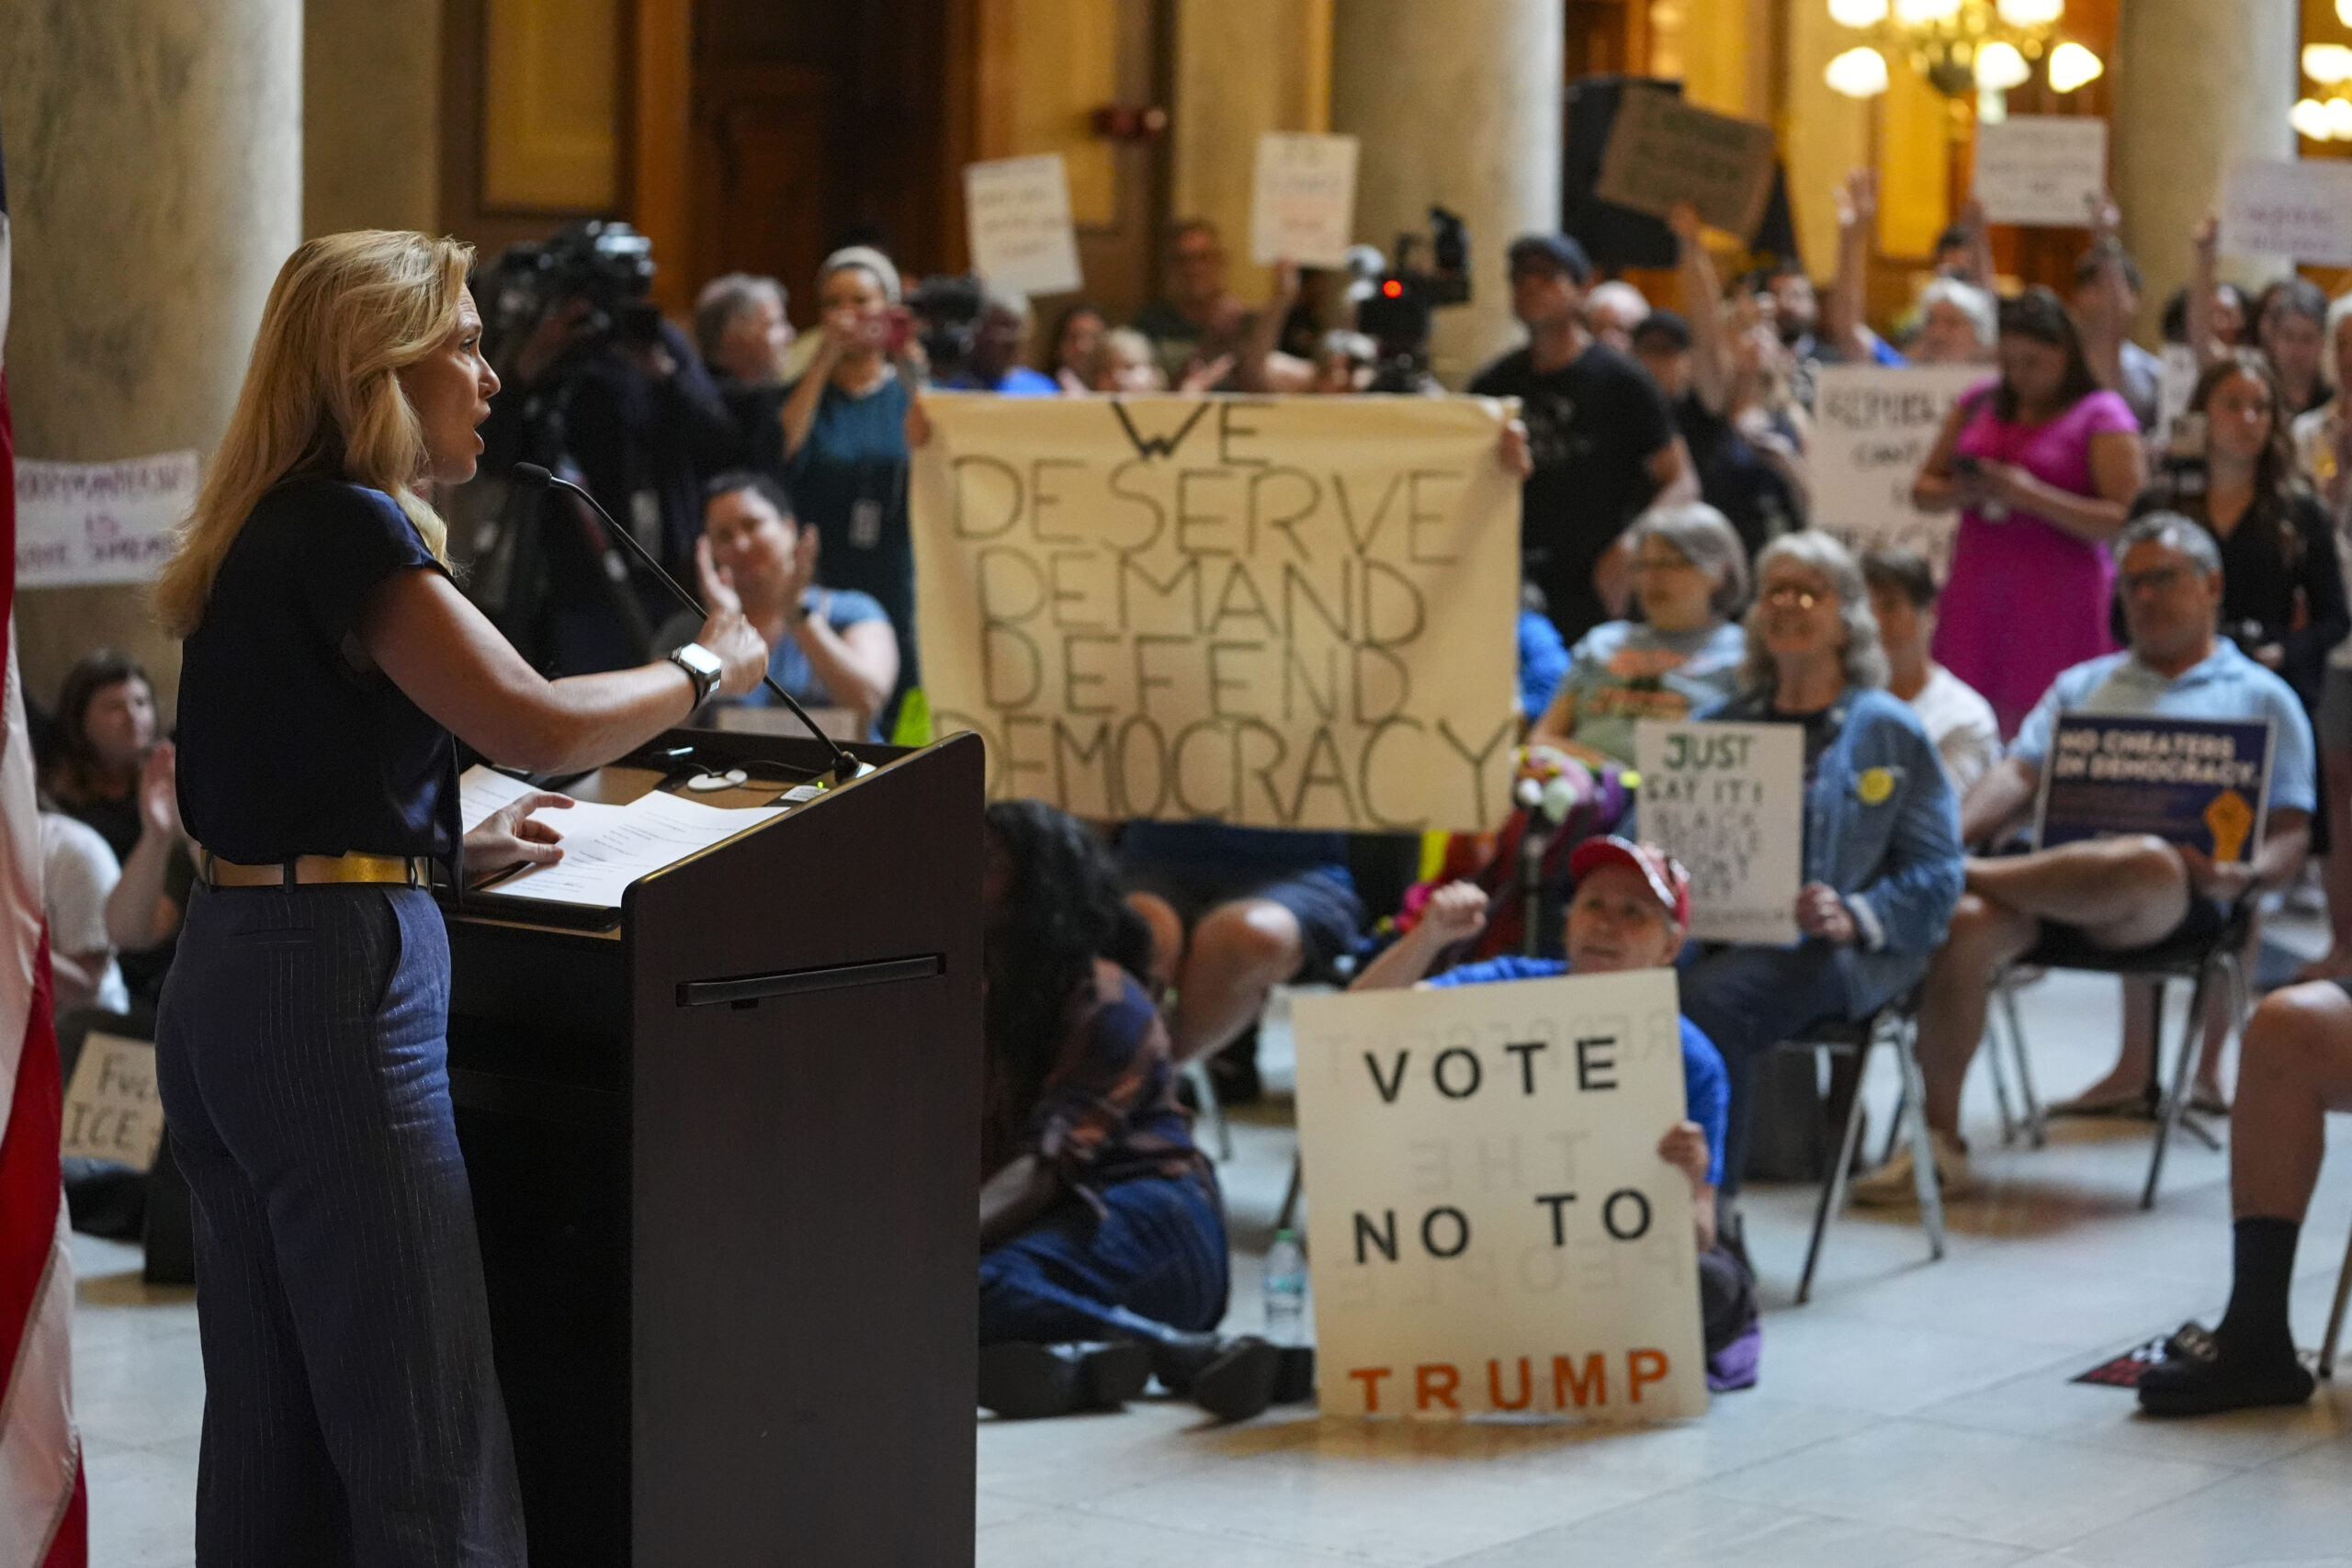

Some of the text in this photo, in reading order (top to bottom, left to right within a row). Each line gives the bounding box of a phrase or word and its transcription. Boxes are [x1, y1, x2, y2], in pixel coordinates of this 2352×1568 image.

[1112, 400, 1276, 467] WE
[952, 457, 1468, 565] DESERVE
[977, 548, 1427, 646] DEMAND
[981, 621, 1413, 726] DEFEND
[1664, 733, 1756, 771] JUST
[2056, 754, 2085, 777] IN
[2059, 730, 2098, 752] NO
[1645, 774, 1699, 802] SAY
[1363, 1036, 1619, 1104] VOTE
[68, 1101, 140, 1151] ICE
[1353, 1188, 1652, 1264] NO TO
[1349, 1348, 1670, 1414] TRUMP
